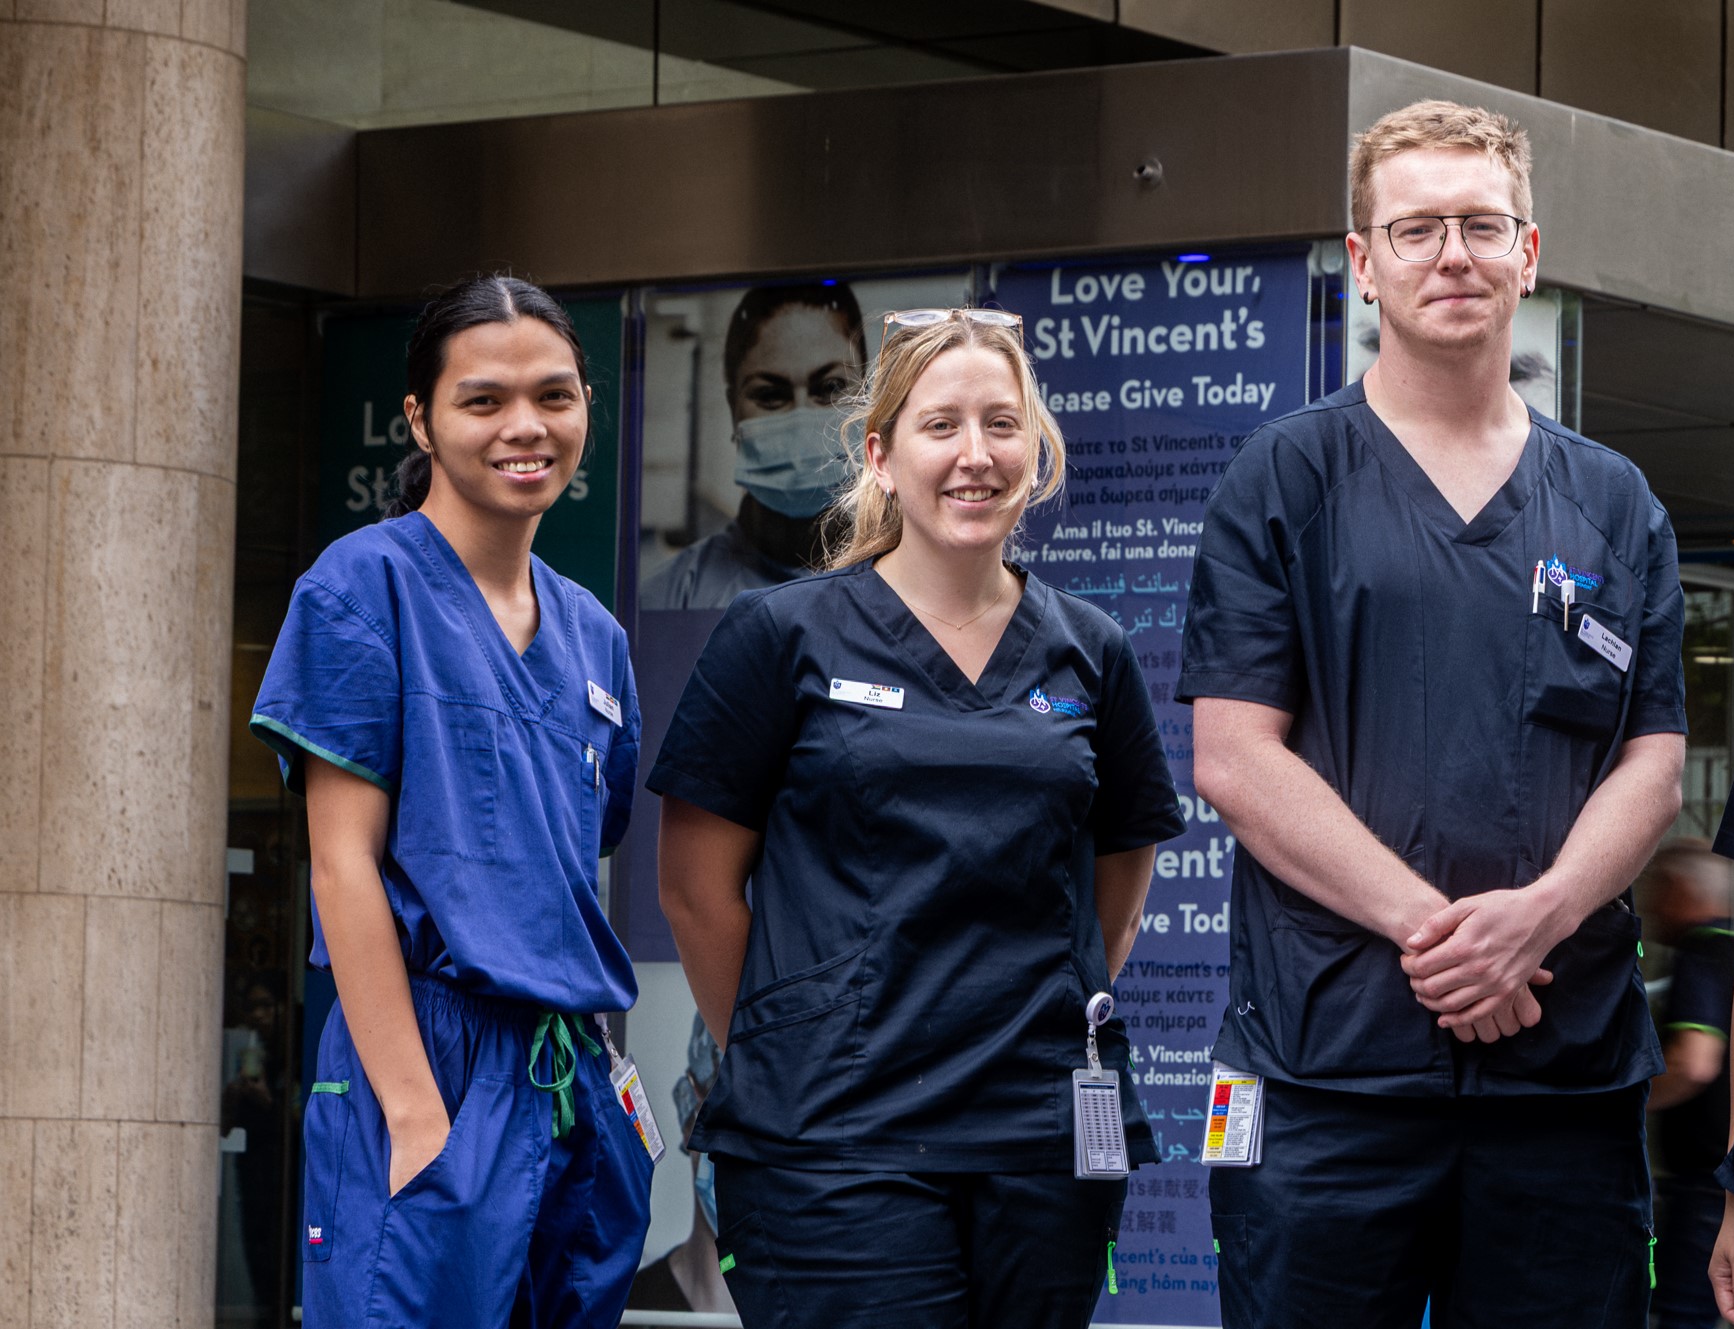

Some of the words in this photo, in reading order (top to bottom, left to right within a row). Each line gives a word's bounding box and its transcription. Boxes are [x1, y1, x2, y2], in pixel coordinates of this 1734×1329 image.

[1051, 268, 1145, 305] Love
[1034, 317, 1075, 359] St
[1081, 306, 1265, 357] Vincent's
[1041, 383, 1112, 413] lease
[1120, 379, 1184, 410] Give
[1192, 372, 1276, 412] Today
[363, 402, 408, 446] Lo
[1131, 436, 1148, 453] St
[1152, 433, 1225, 452] Vincent's
[1052, 523, 1088, 540] Ama
[1092, 520, 1101, 539] il
[1105, 522, 1132, 538] tuo
[1136, 519, 1158, 537] St.
[1011, 546, 1037, 563] Per
[1042, 544, 1097, 563] favore,
[1100, 541, 1121, 560] fai
[1125, 545, 1153, 559] una
[1601, 633, 1622, 652] Lachlan
[1601, 644, 1616, 659] Nurse
[1178, 902, 1229, 934] Tod
[1140, 961, 1211, 978] Vincent's
